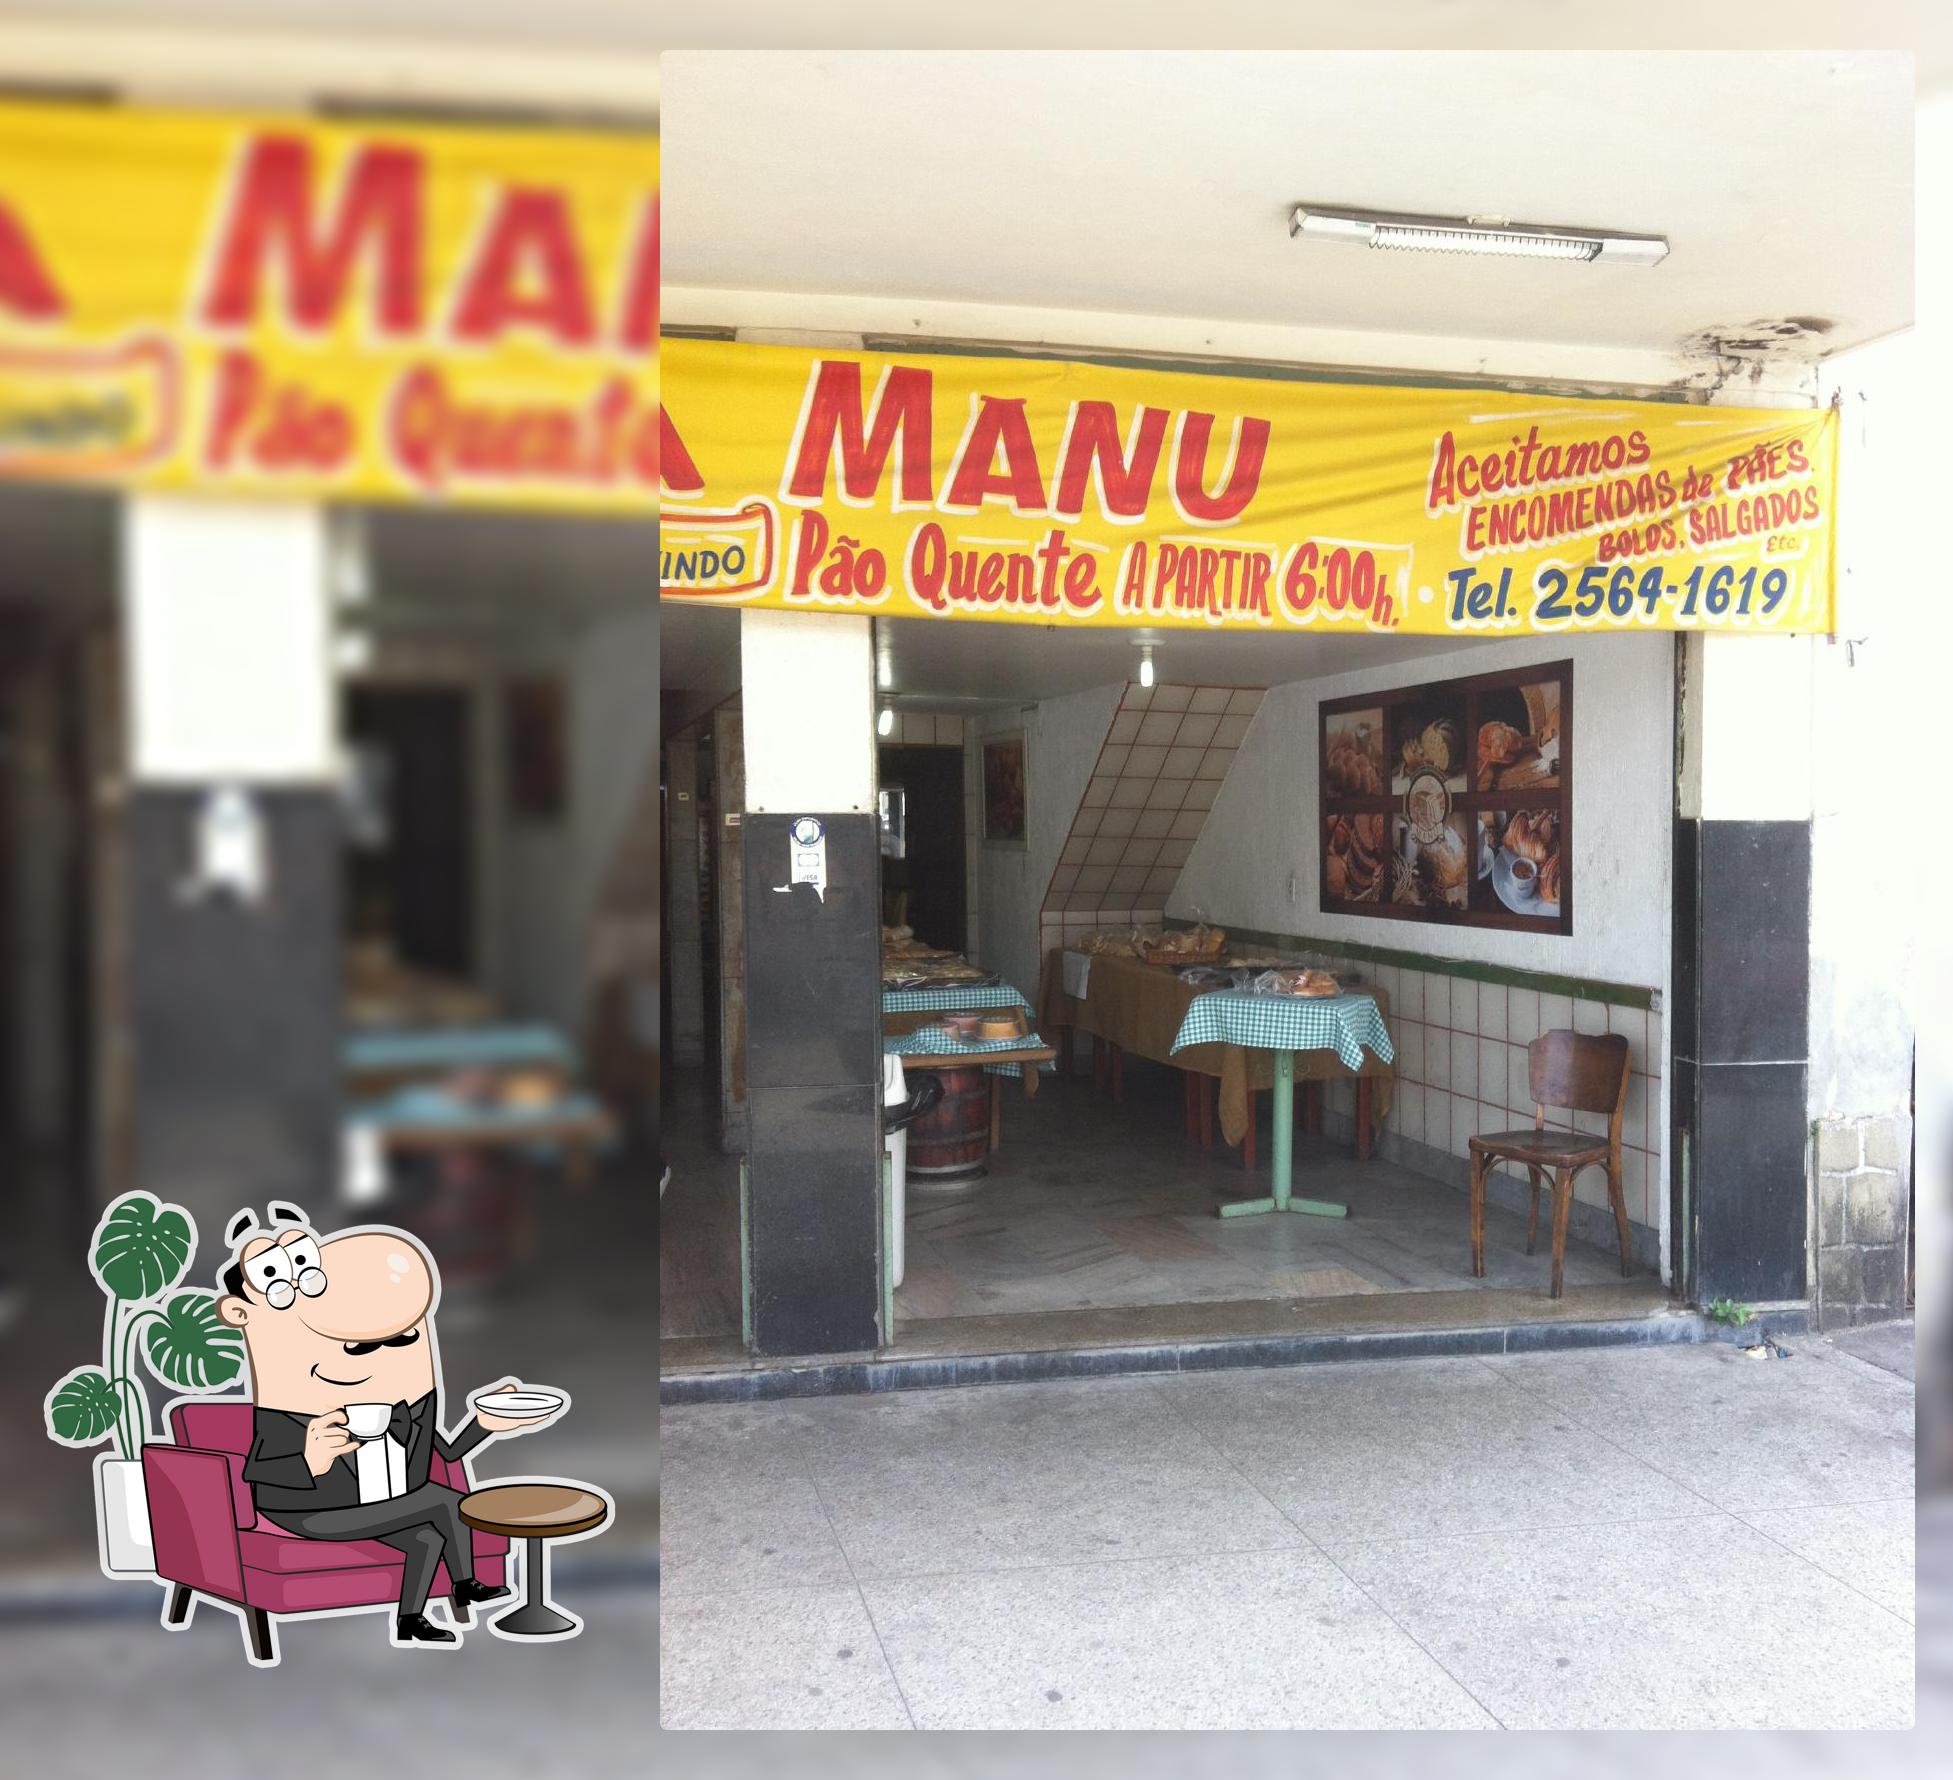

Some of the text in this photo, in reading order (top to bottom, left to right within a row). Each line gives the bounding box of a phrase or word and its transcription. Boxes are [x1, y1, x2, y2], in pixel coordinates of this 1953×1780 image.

[789, 360, 1271, 521] MANU
[1429, 425, 1651, 508] Aceitamos
[1466, 469, 1677, 551] ENCOMENDAS
[1682, 465, 1714, 502] de
[1689, 485, 1820, 545] SALGADOS
[660, 545, 745, 580] INDO
[791, 509, 887, 597] Pão
[911, 522, 1102, 610] Quente
[1122, 541, 1147, 608] A
[1153, 543, 1272, 617] PARTIR
[1448, 566, 1788, 621] Tel. 2564-1619
